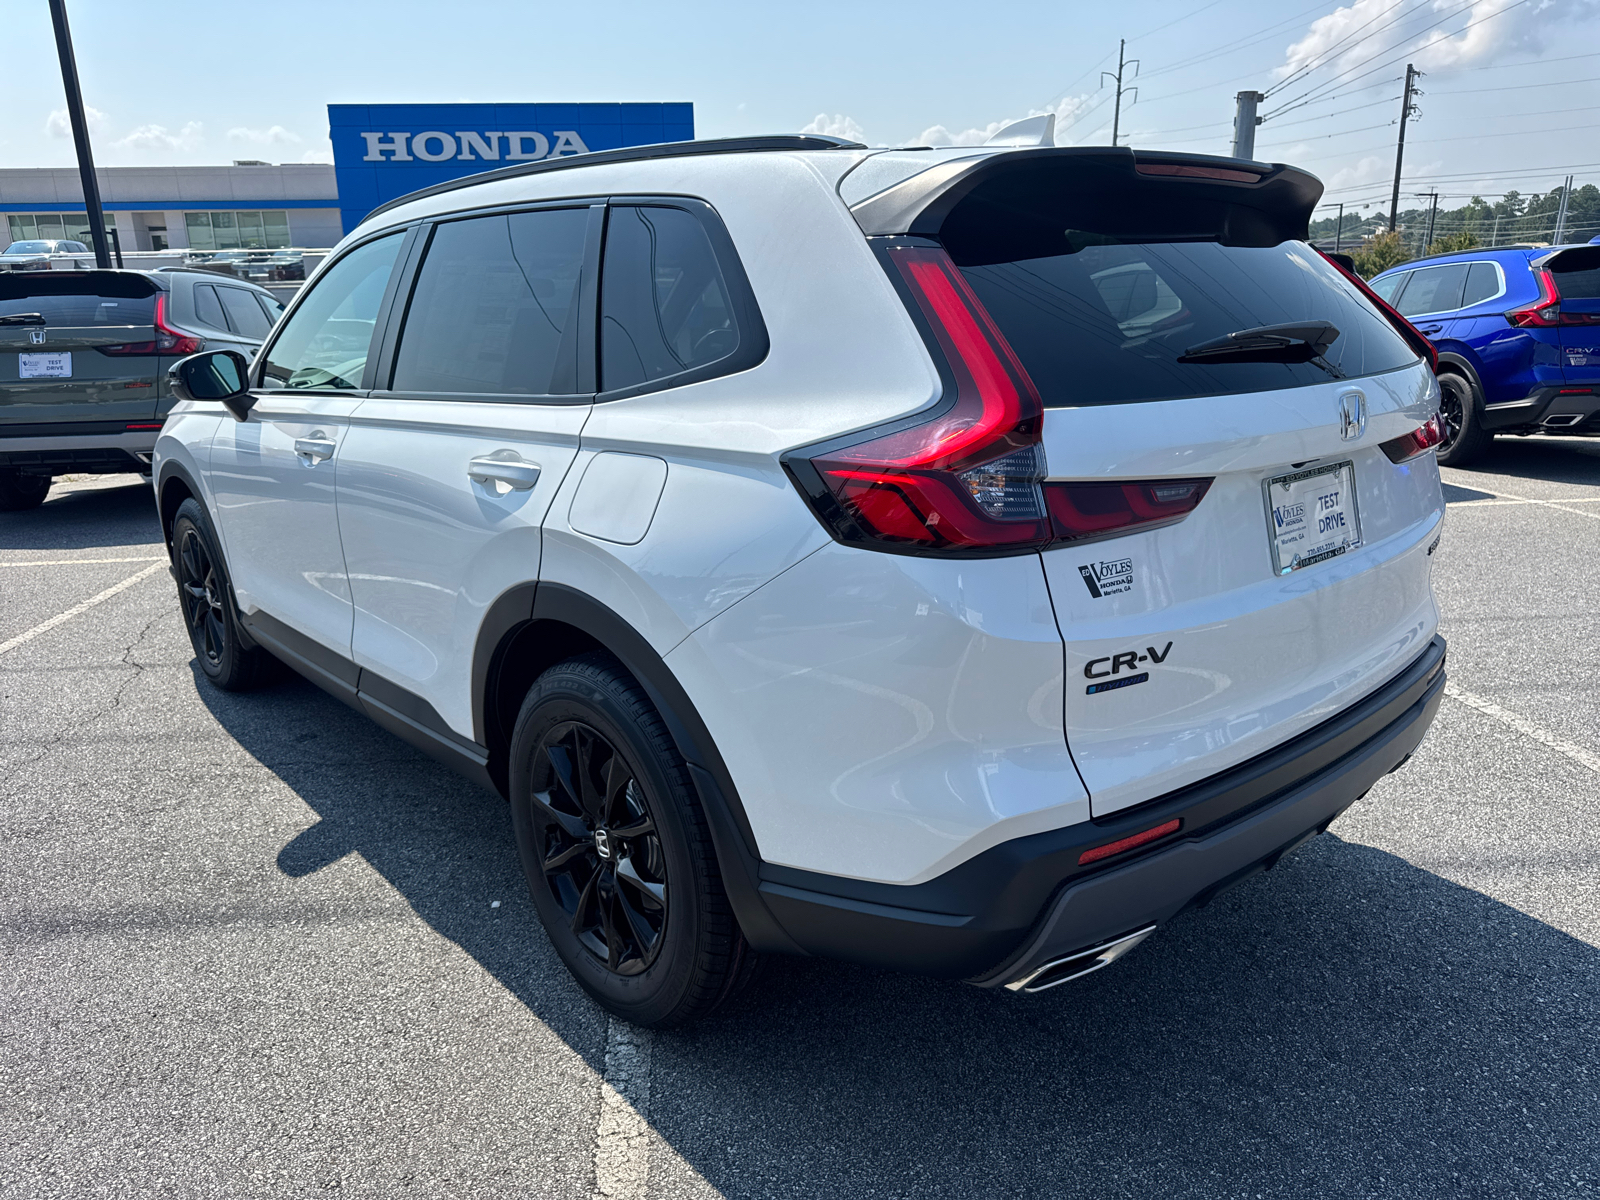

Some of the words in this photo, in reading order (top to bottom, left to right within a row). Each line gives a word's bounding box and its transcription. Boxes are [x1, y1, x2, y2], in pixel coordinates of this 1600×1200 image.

[361, 131, 590, 162] HONDA
[1318, 492, 1340, 512] TEST
[1318, 512, 1346, 533] DRIVE
[1335, 546, 1345, 557] GA
[1090, 560, 1132, 583] VOYLES
[1100, 579, 1126, 589] HONDA
[1084, 641, 1173, 679] CR-V
